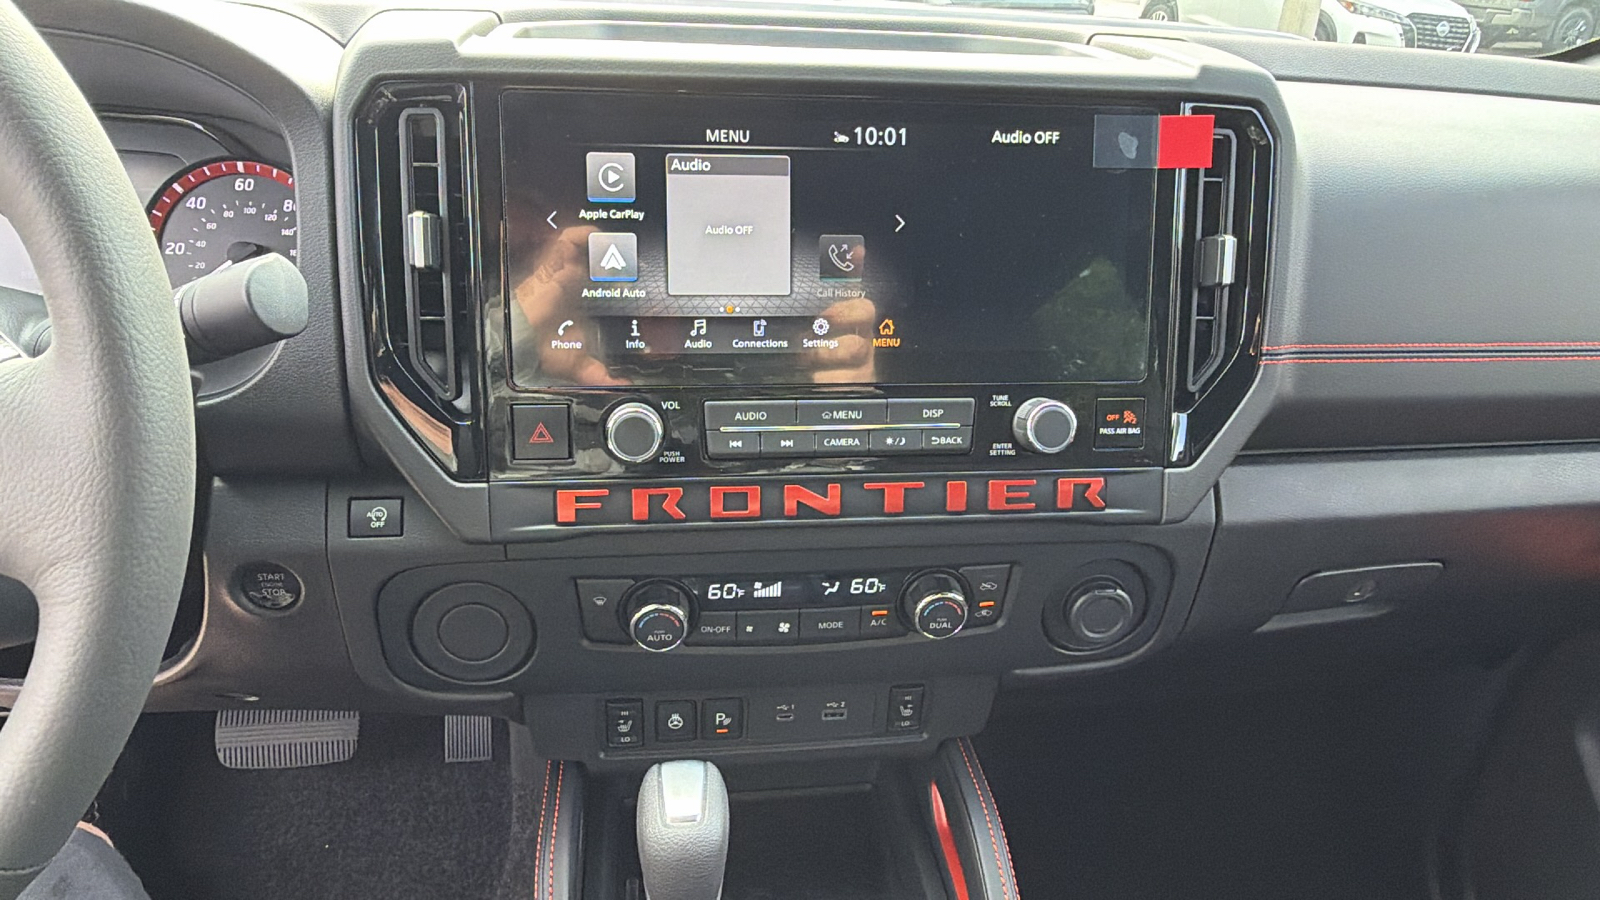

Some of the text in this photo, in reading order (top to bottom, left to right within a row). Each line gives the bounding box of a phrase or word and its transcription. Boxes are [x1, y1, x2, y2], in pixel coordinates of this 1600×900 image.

[706, 130, 750, 142] MENU
[854, 126, 907, 146] 10:01
[992, 130, 1060, 143] Audio OFF
[671, 158, 711, 172] Audio
[234, 178, 254, 191] 60
[186, 197, 206, 209] 40
[579, 209, 644, 220] Apple CarPlay
[705, 225, 753, 235] Audio OFF
[164, 242, 185, 254] 20
[582, 288, 646, 298] Android Auto
[817, 288, 866, 300] Call History
[552, 339, 582, 349] Phone
[626, 339, 646, 348] Info
[684, 338, 712, 348] Audio
[732, 338, 788, 348] Connections
[802, 338, 838, 349] Settings
[872, 338, 900, 348] MENU
[662, 401, 680, 410] VOL
[734, 411, 767, 421] AUDIO
[833, 410, 862, 420] MENU
[922, 408, 944, 418] DISP
[824, 438, 860, 446] CAMERA
[940, 436, 962, 444] BACK
[556, 478, 1106, 522] FRONTIER
[818, 620, 844, 629] MODE
[870, 618, 887, 626] A/C
